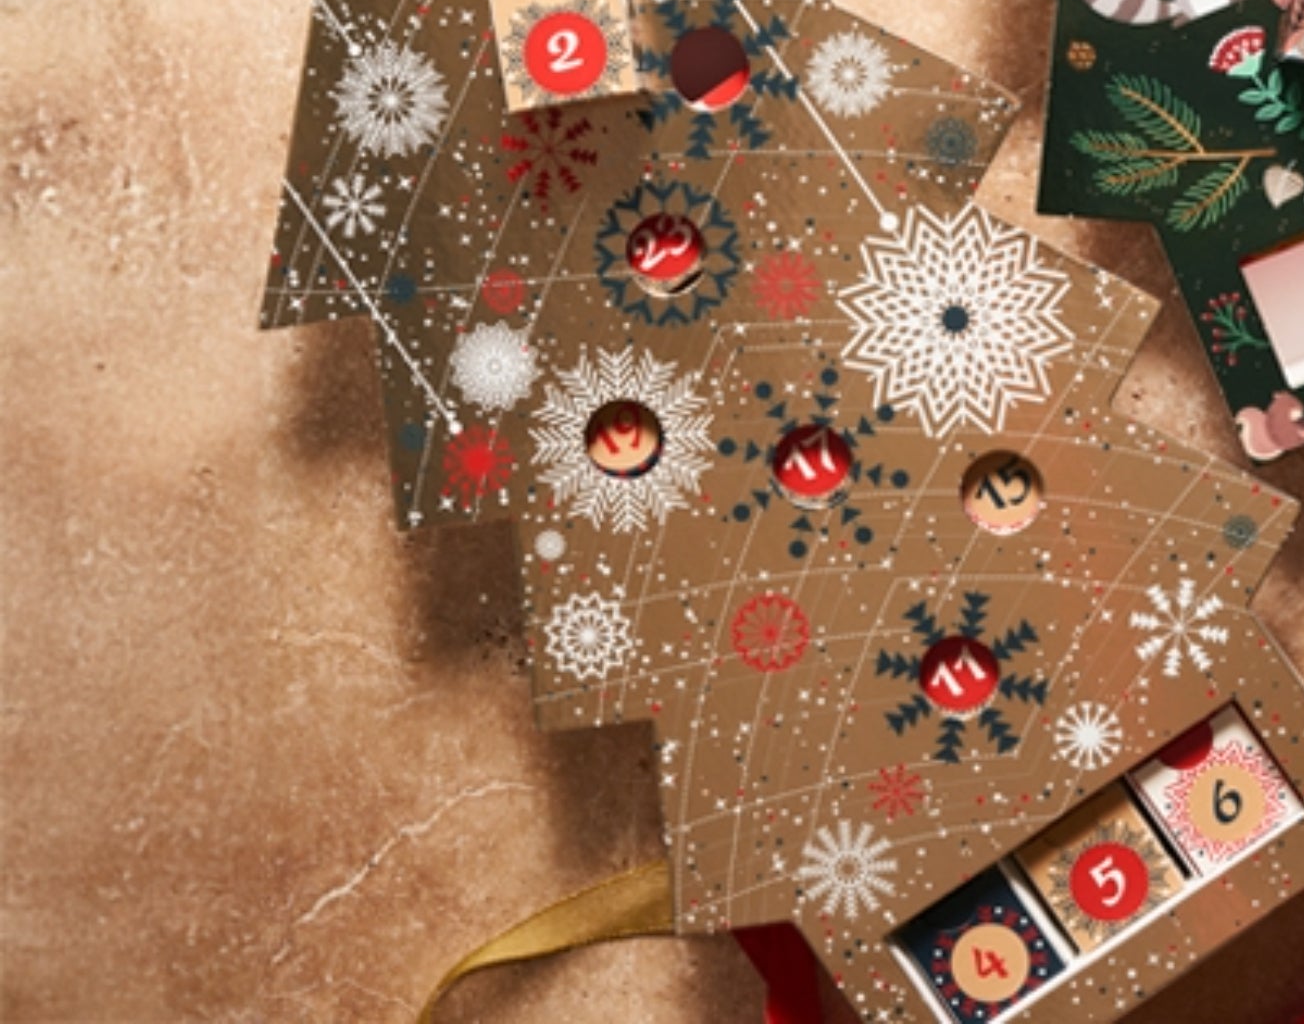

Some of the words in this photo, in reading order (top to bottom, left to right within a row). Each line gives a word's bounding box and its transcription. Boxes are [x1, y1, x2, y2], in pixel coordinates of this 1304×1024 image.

[546, 29, 584, 74] 2
[630, 216, 692, 272] 23
[590, 402, 642, 455] 19
[783, 429, 837, 480] 17
[975, 458, 1032, 510] 15
[930, 646, 989, 698] 11
[1211, 778, 1243, 824] 6
[1088, 856, 1127, 908] 5
[971, 947, 1009, 980] 4
